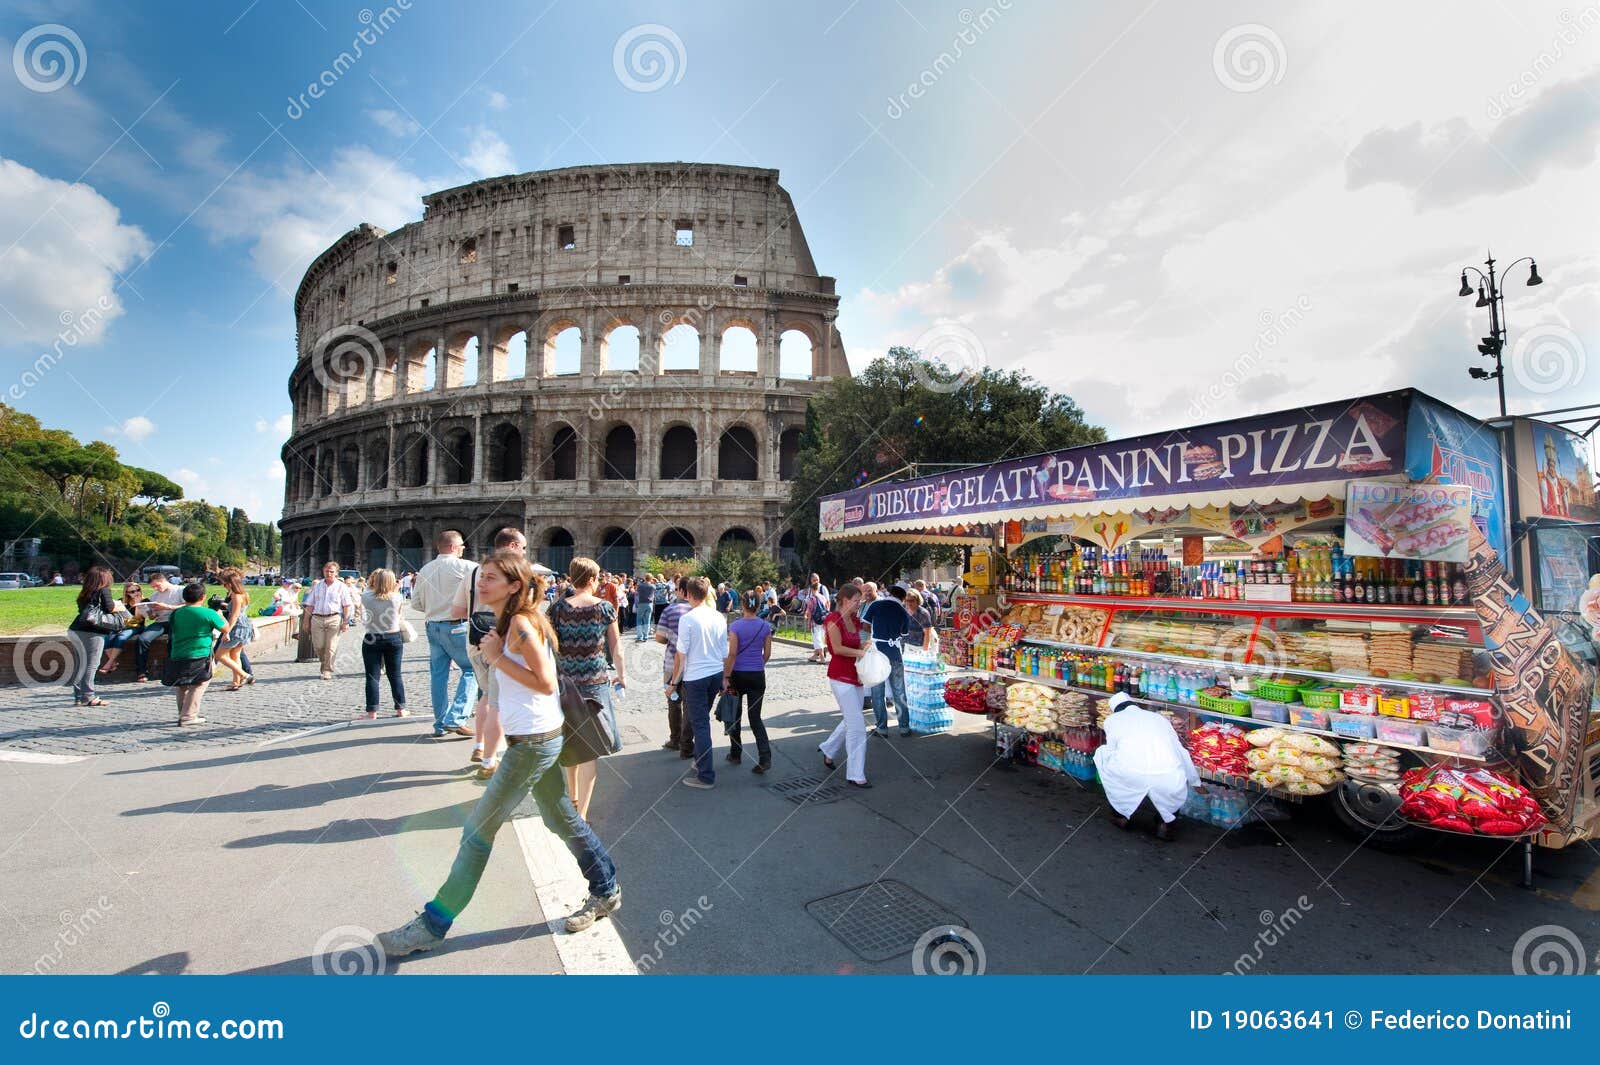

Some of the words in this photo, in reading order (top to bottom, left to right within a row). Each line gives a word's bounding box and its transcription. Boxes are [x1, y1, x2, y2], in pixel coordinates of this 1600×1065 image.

[876, 484, 935, 518] BIBITE
[944, 465, 1041, 512] GELATI
[1056, 440, 1195, 494] PANINI
[1220, 414, 1392, 477] PIZZA
[1408, 487, 1468, 507] DOG
